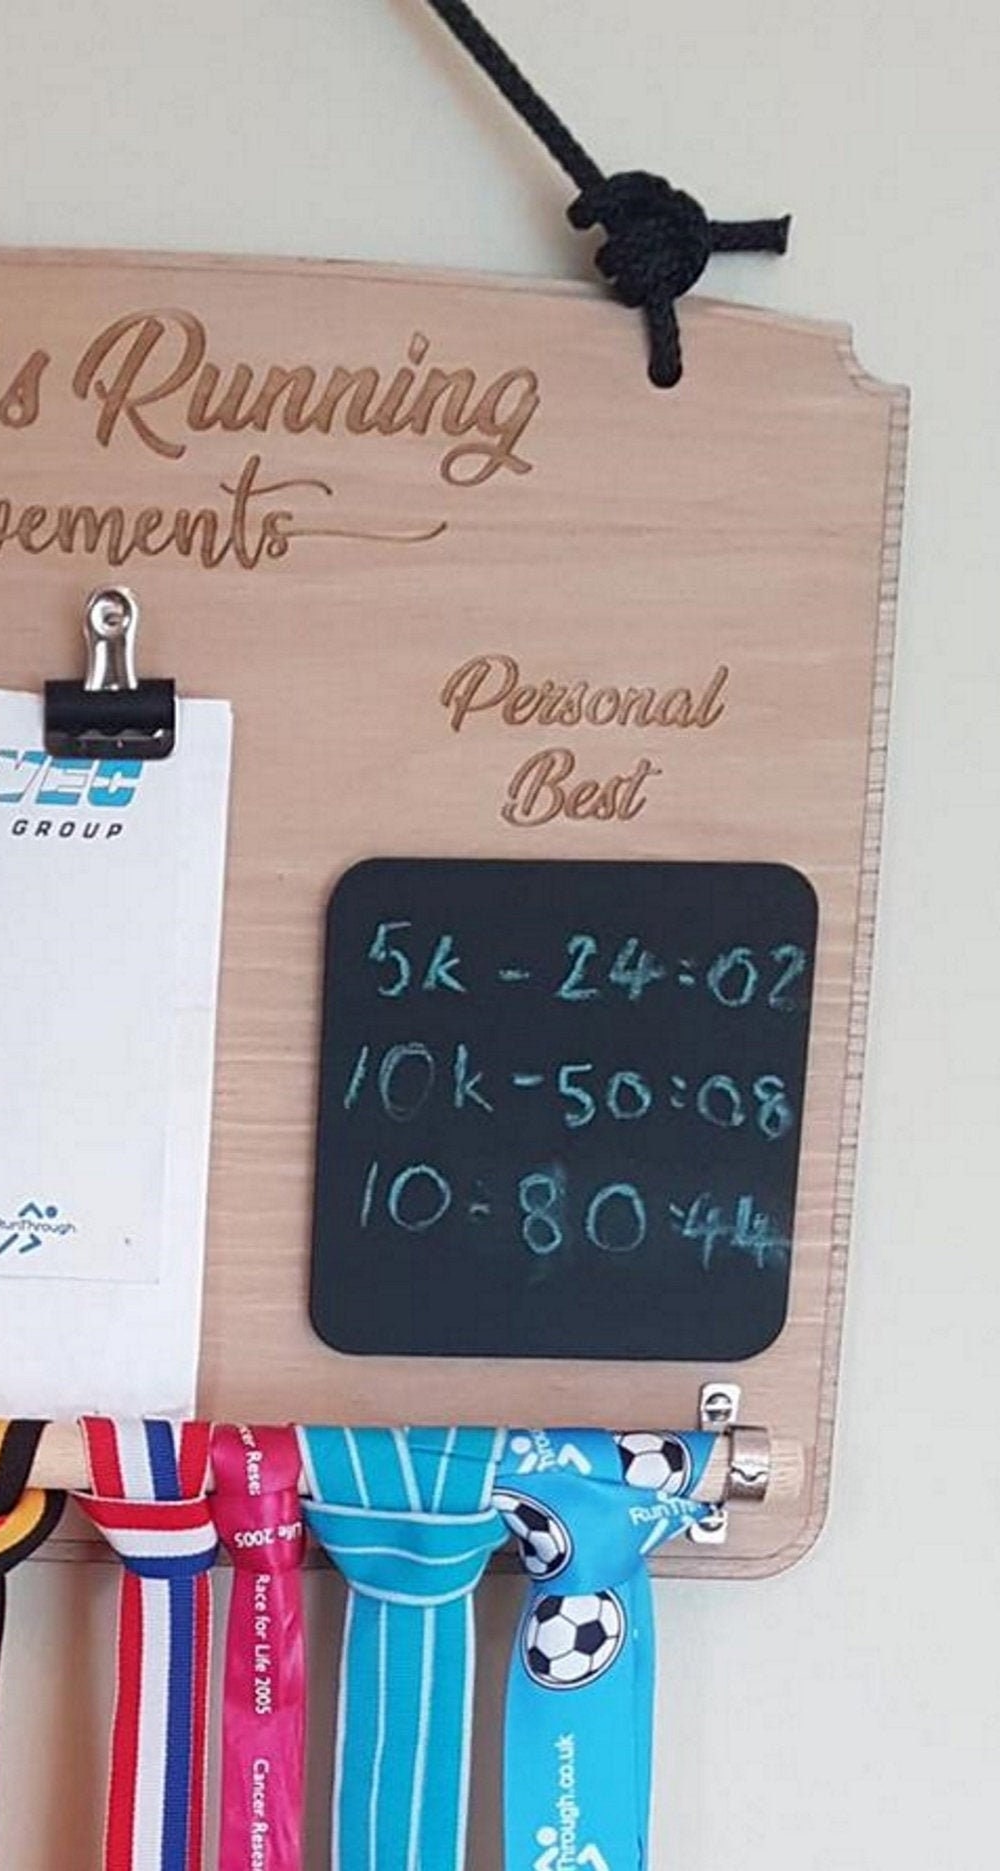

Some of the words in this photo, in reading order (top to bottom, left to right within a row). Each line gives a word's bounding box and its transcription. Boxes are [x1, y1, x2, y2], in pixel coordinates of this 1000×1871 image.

[74, 306, 541, 485] Running
[441, 653, 728, 733] Personal
[501, 747, 662, 828] Best
[11, 818, 125, 839] GROUP
[233, 1528, 276, 1549] 2005
[254, 1573, 271, 1612] Race
[254, 1616, 271, 1641] for
[254, 1644, 271, 1673] Life
[254, 1677, 272, 1715] 2005
[252, 1758, 270, 1818] Cancer
[250, 1821, 270, 1871] Resea
